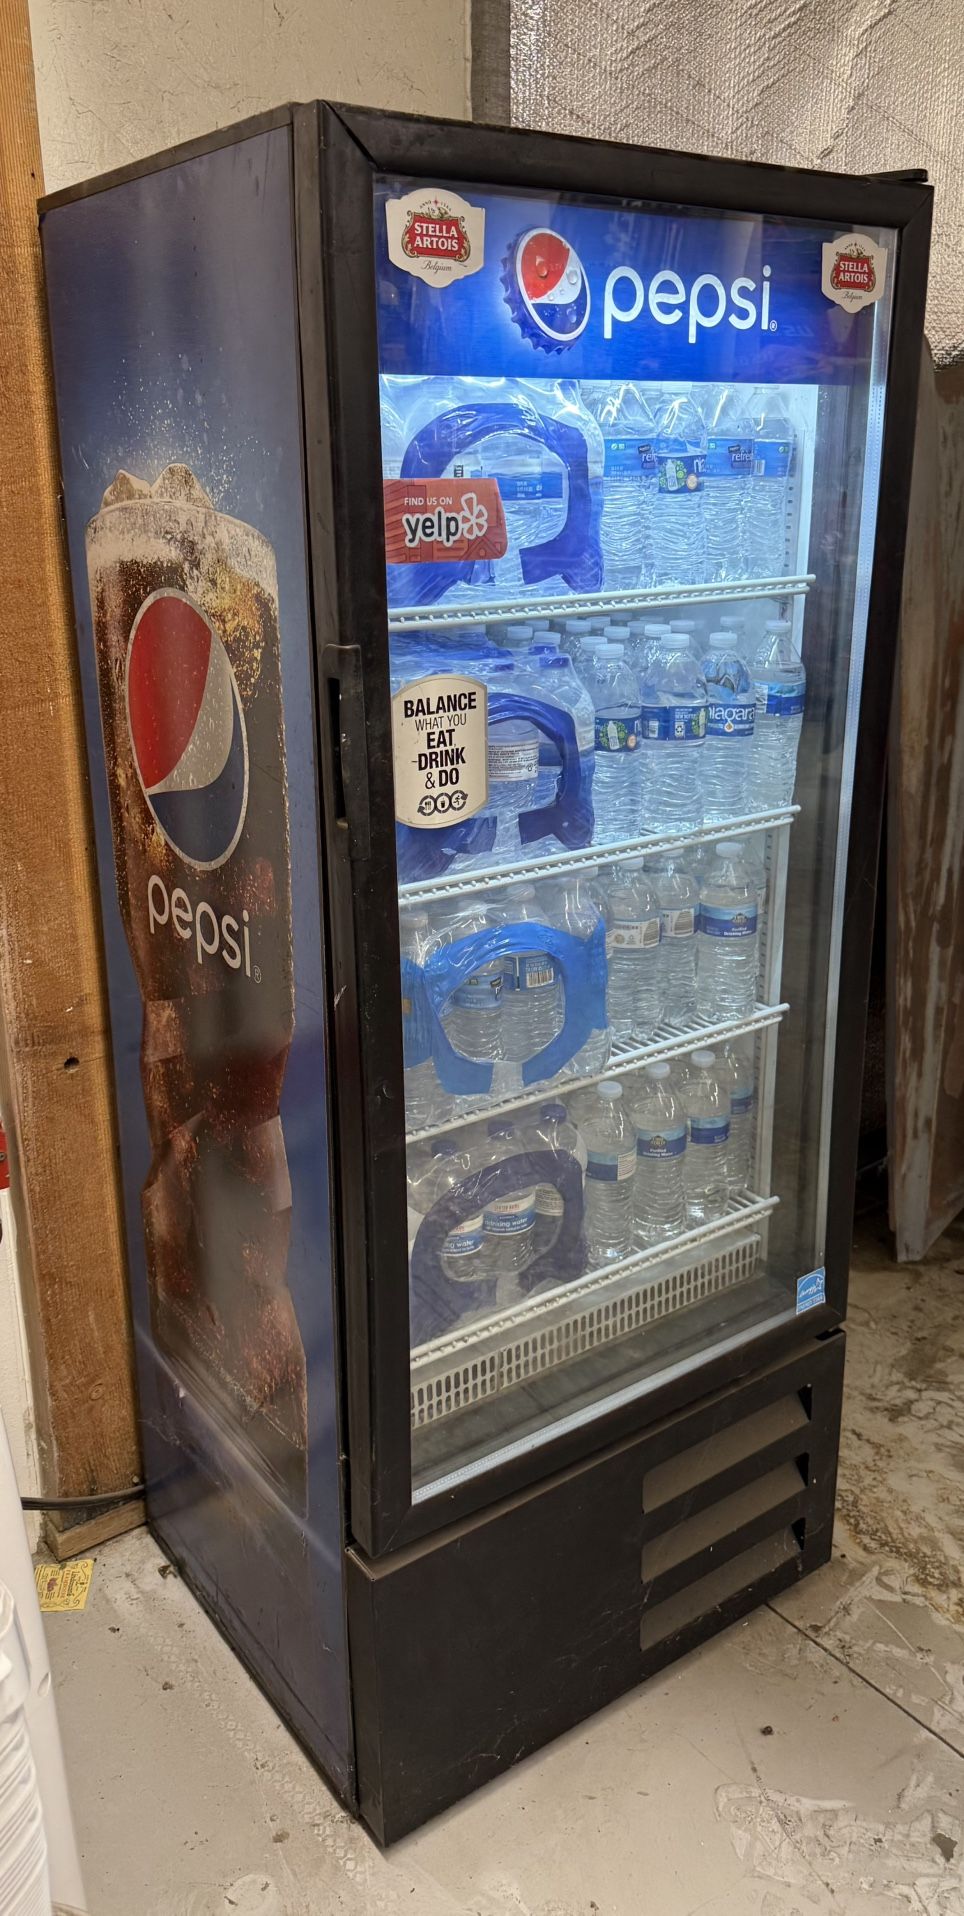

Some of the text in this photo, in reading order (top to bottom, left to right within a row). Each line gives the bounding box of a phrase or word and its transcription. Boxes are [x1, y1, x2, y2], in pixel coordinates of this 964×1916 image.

[414, 222, 458, 238] STELLA
[414, 236, 459, 251] ARTOIS
[421, 259, 452, 274] Belgium
[839, 261, 869, 273] STELLA
[838, 272, 869, 283] ARTOIS
[603, 265, 770, 344] pepsi
[404, 496, 453, 506] FIND US ON
[404, 510, 460, 544] yelp
[403, 691, 477, 718] BALANCE
[415, 713, 467, 731] WHAT YOU
[425, 767, 460, 789] & DO
[147, 874, 251, 977] pepsi
[511, 1216, 529, 1227] water
[456, 1239, 475, 1248] water
